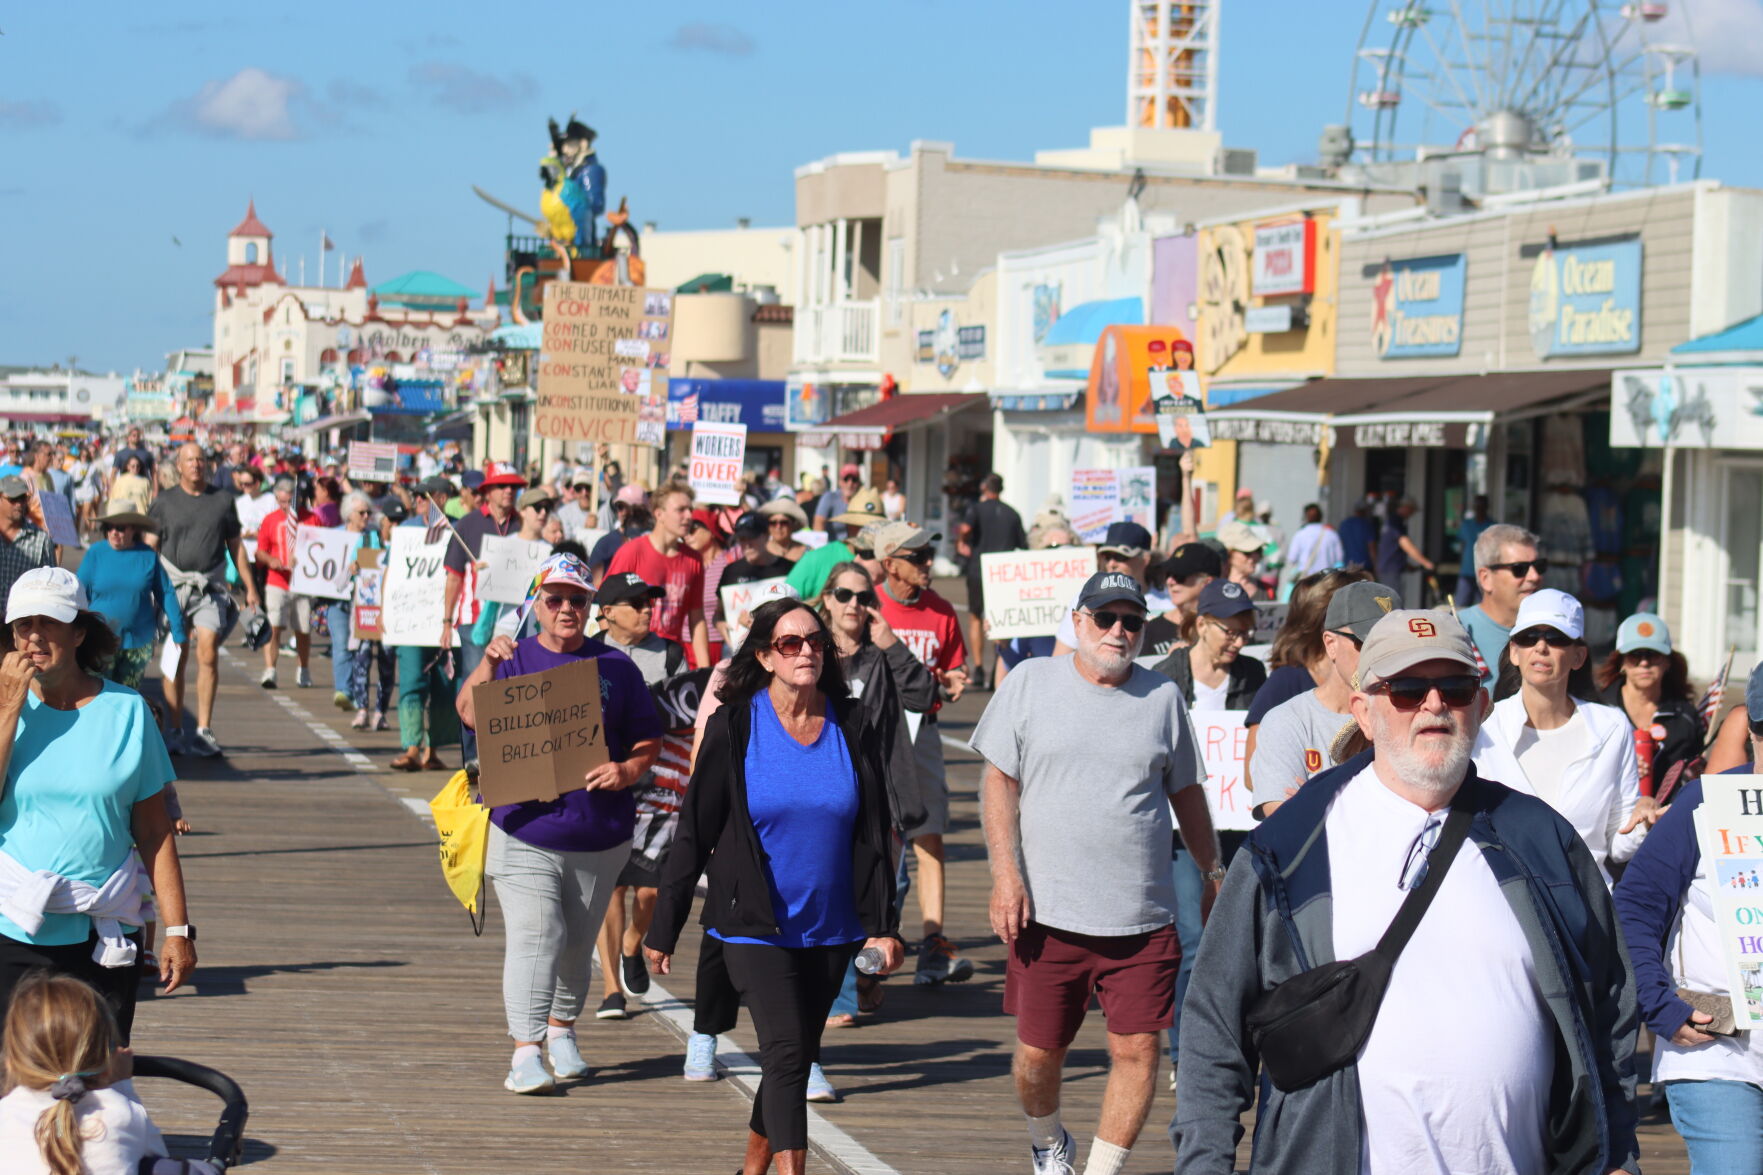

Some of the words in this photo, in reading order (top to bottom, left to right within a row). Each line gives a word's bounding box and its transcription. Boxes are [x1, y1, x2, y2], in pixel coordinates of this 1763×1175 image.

[1563, 254, 1615, 296] Ocean
[551, 284, 574, 300] THE
[579, 288, 637, 303] ULTIMATE
[556, 300, 590, 317] CON
[600, 305, 630, 319] MAN
[1560, 296, 1632, 344] Paradise
[544, 322, 598, 338] CONNED
[606, 325, 634, 340] MAN
[607, 355, 636, 366] MAN
[542, 363, 612, 379] CONSTANT
[588, 379, 618, 391] LIAR
[538, 394, 638, 414] UNCONSTITUTIONAL
[695, 435, 742, 457] WORKERS
[692, 462, 738, 481] OVER
[405, 556, 442, 579] YOU
[988, 558, 1089, 583] HEALTHCARE
[1019, 586, 1055, 599] NOT
[504, 681, 552, 704] STOP
[489, 702, 590, 735] BILLIONAIRE
[502, 724, 599, 763] BAILOUTS!
